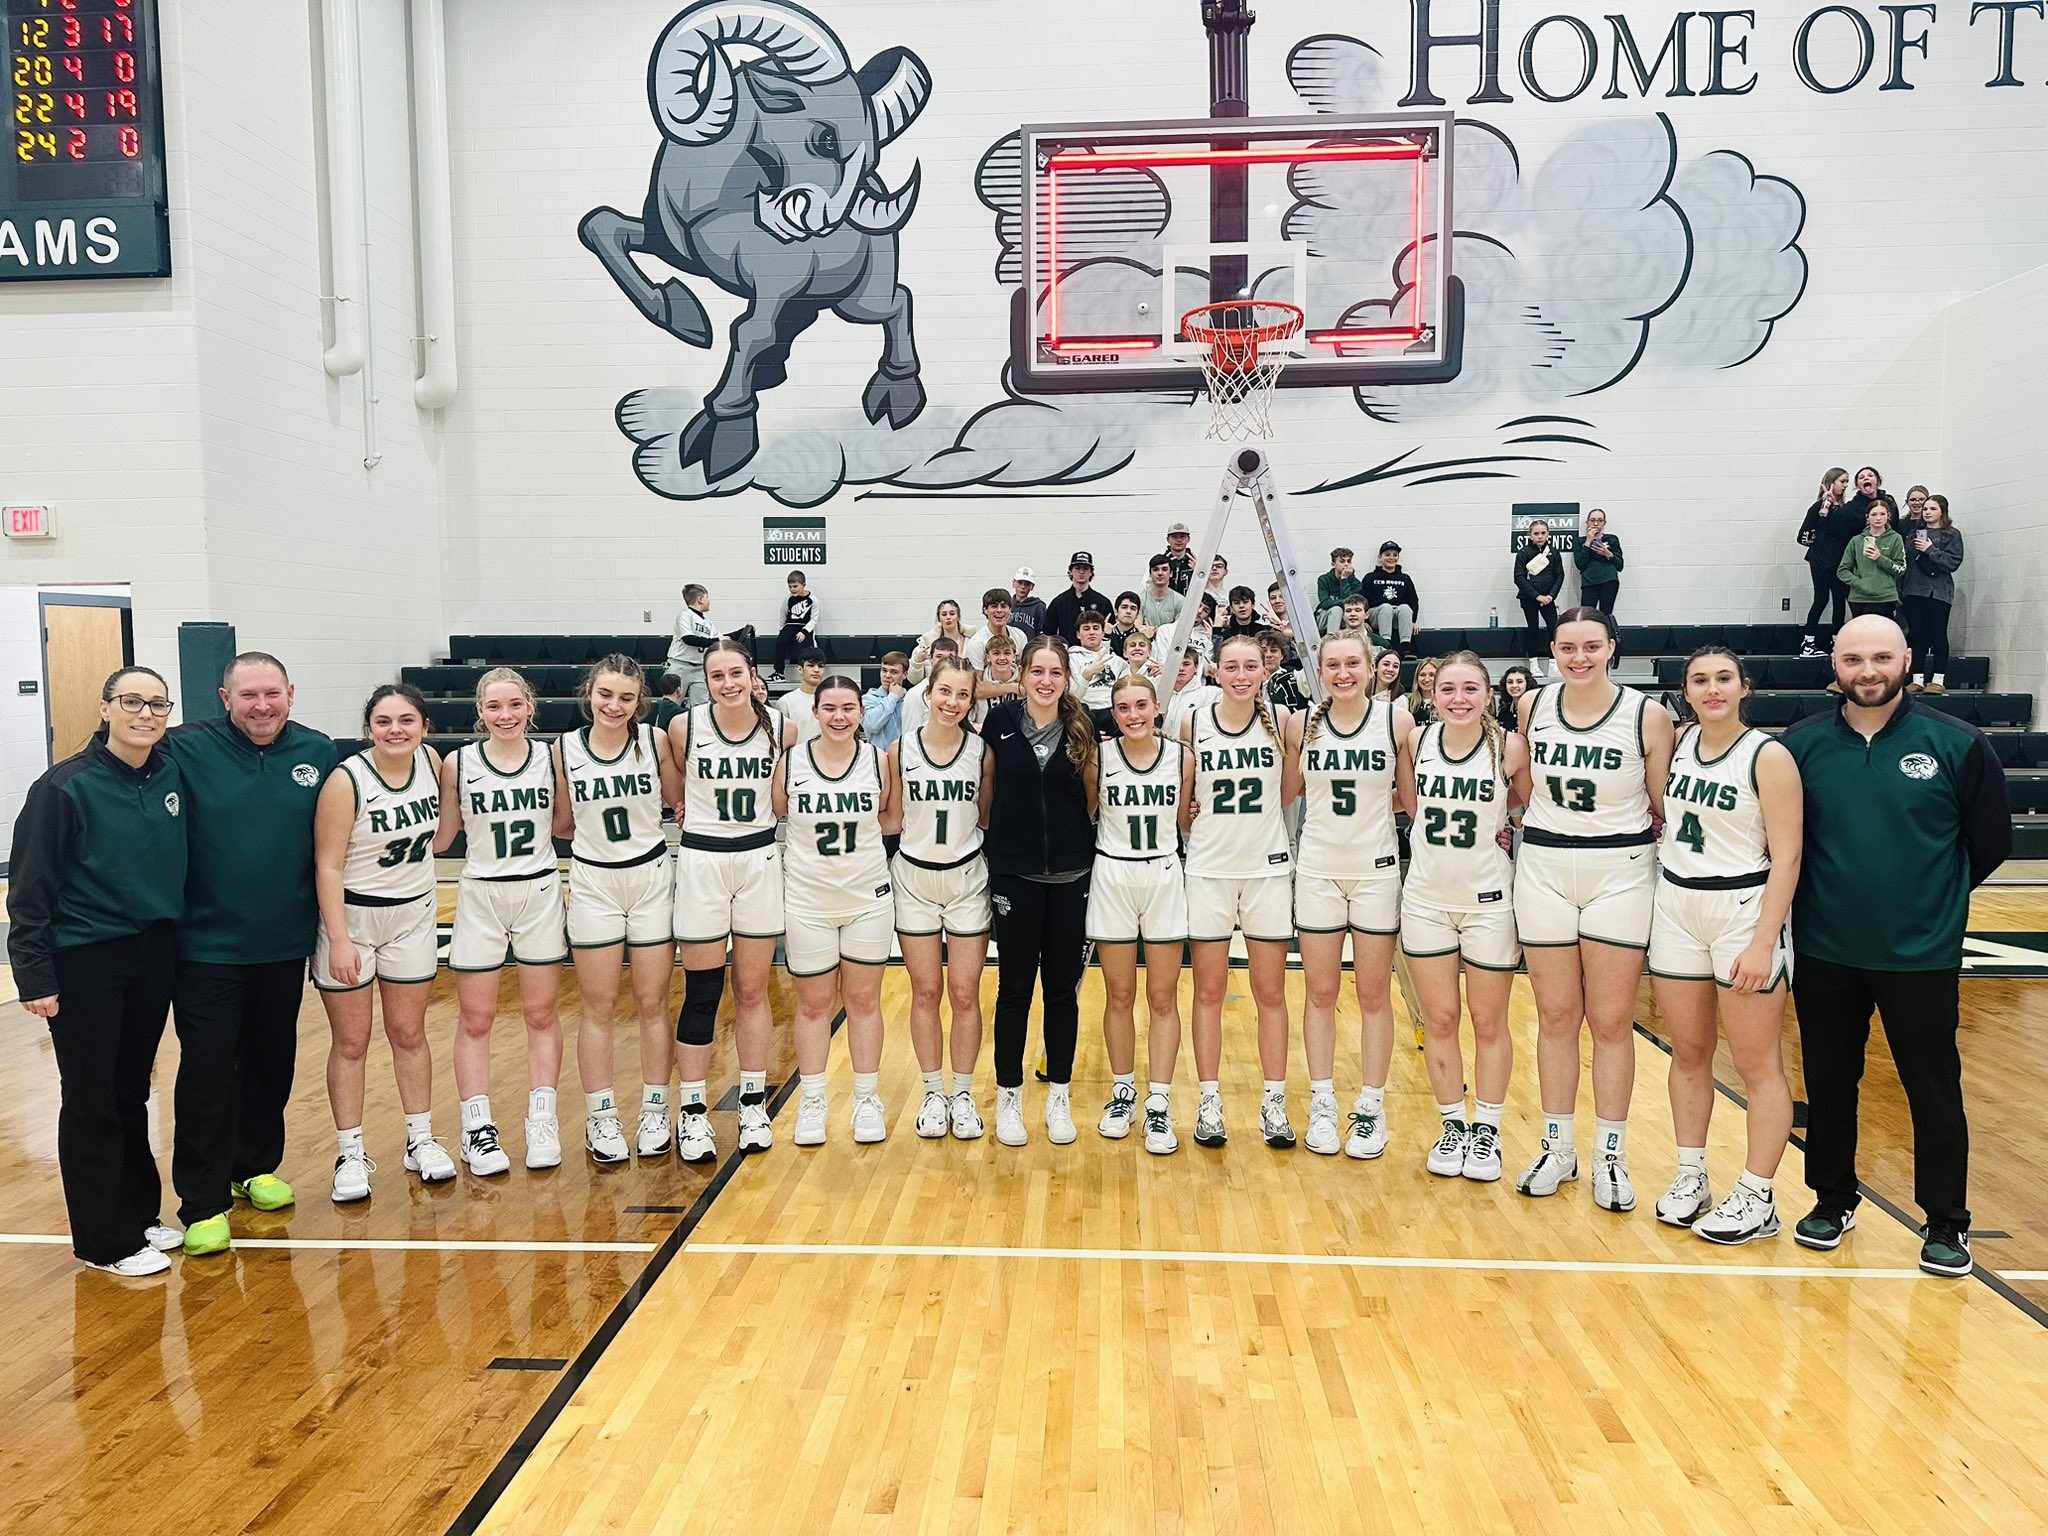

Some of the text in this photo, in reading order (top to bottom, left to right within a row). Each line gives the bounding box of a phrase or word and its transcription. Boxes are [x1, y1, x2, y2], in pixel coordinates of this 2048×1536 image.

[22, 13, 134, 48] 12 3 17
[14, 52, 135, 87] 20 4 0
[1397, 0, 2048, 106] HOME OF T
[15, 88, 137, 124] 22 4 19
[17, 126, 139, 161] 24 2 0
[1072, 354, 1119, 362] GARED
[12, 509, 41, 533] EXIT
[784, 531, 820, 541] RAM
[769, 547, 822, 563] STUDENTS
[697, 757, 774, 780] RAMS
[1201, 746, 1274, 772] RAMS
[1307, 749, 1387, 772] RAMS
[1533, 741, 1624, 770] RAMS
[469, 787, 550, 815] RAMS
[572, 773, 652, 802] RAMS
[798, 792, 873, 814] RAMS
[907, 779, 976, 801] RAMS
[1106, 784, 1177, 806] RAMS
[1212, 777, 1263, 815] 22
[1330, 779, 1357, 817] 5
[1416, 773, 1495, 802] RAMS
[1545, 775, 1597, 813] 13
[1665, 772, 1739, 811] RAMS
[368, 794, 440, 833] RAMS
[714, 788, 757, 823] 10
[490, 819, 535, 858] 12
[602, 806, 631, 842] 0
[815, 821, 859, 856] 21
[935, 810, 949, 844] 1
[1127, 815, 1159, 850] 11
[1424, 806, 1478, 849] 23
[1676, 810, 1705, 854] 4
